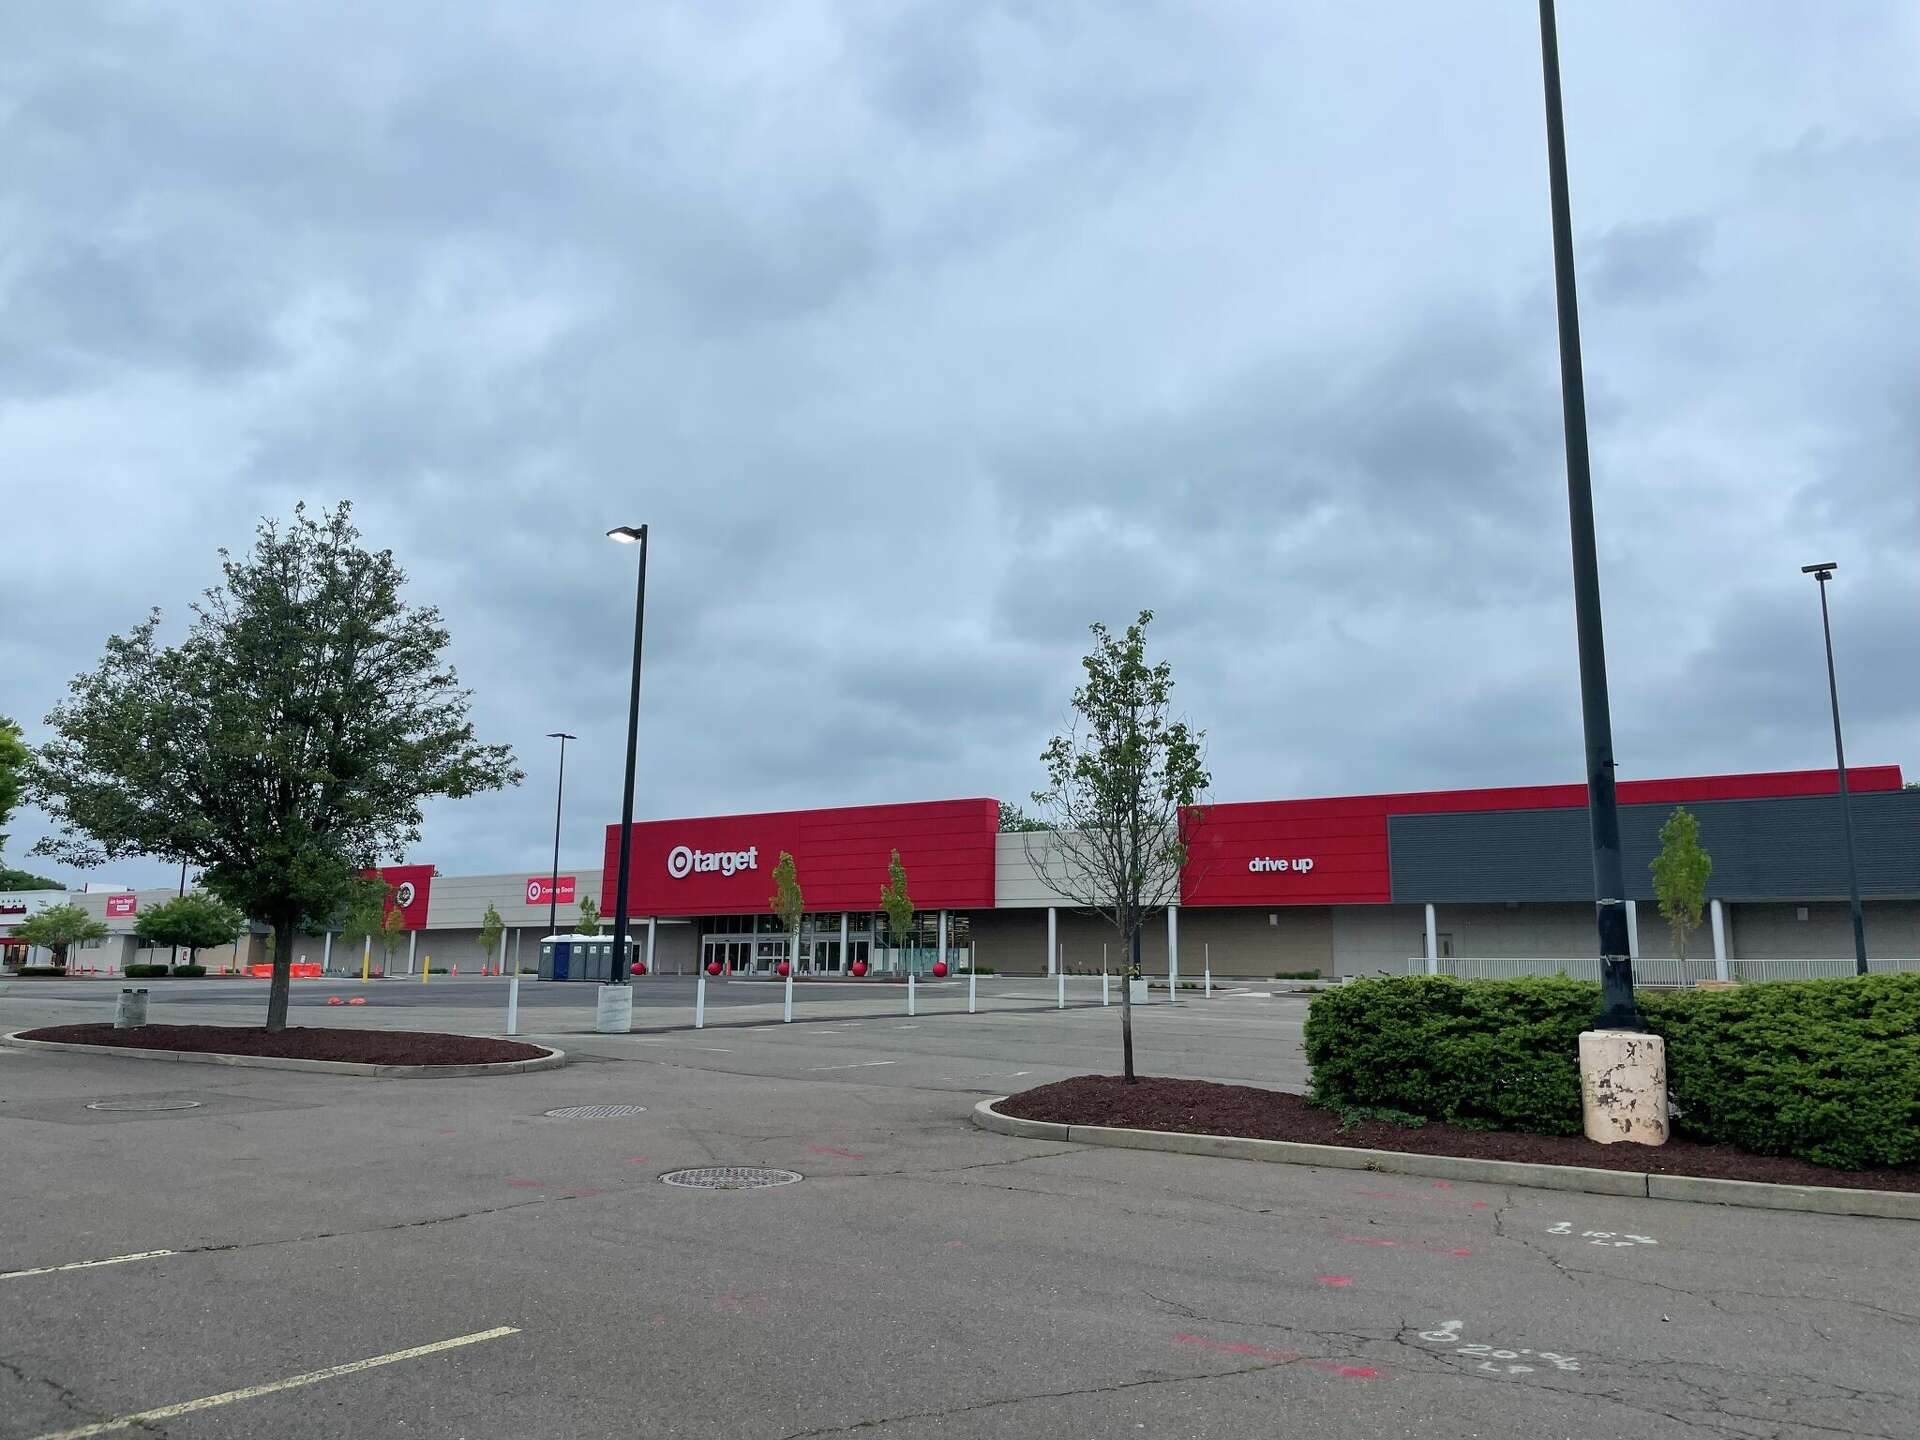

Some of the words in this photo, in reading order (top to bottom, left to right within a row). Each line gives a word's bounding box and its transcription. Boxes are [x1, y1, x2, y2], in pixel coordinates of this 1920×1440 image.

[693, 846, 758, 877] target
[1248, 857, 1288, 872] drive
[1292, 858, 1314, 873] up
